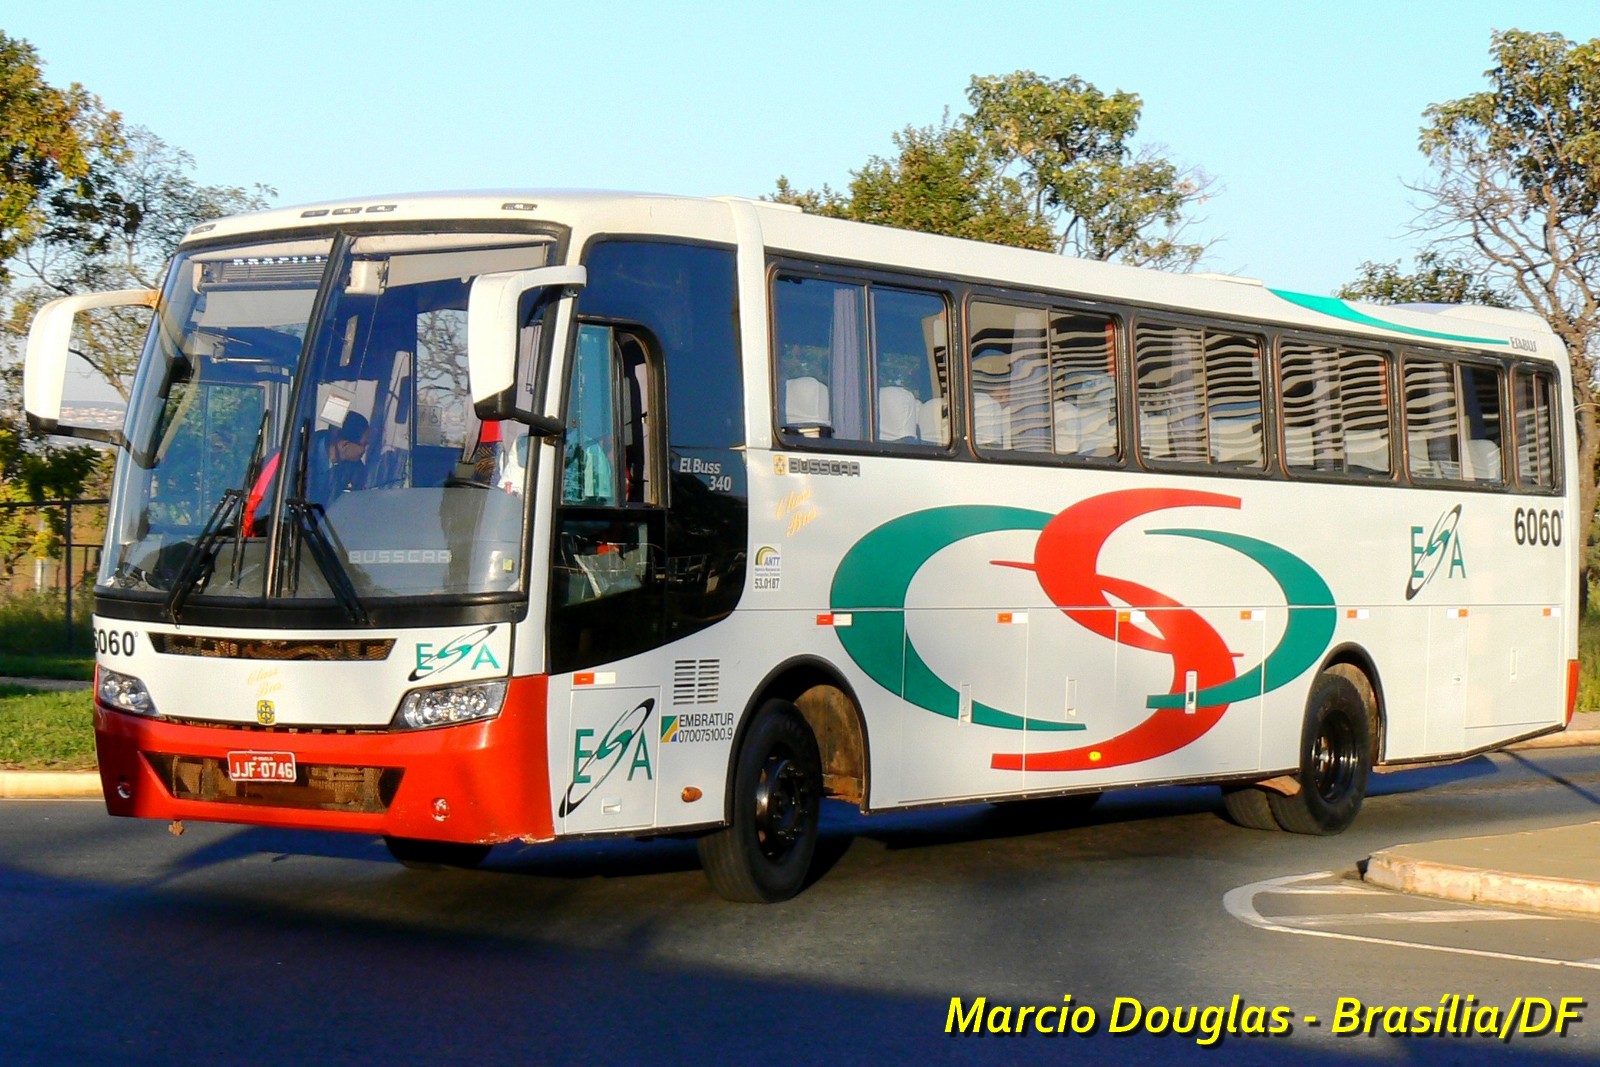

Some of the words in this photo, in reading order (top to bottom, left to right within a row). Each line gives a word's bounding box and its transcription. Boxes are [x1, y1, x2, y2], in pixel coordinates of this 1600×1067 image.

[788, 457, 861, 477] BUSSCAR
[709, 475, 732, 491] 340
[1514, 507, 1562, 547] 6060
[348, 549, 451, 564] BUSSCAR
[764, 556, 780, 566] ANTT
[679, 713, 734, 728] EMBRATUR
[678, 727, 733, 743] 070075100.9
[232, 761, 293, 778] JJF-0746
